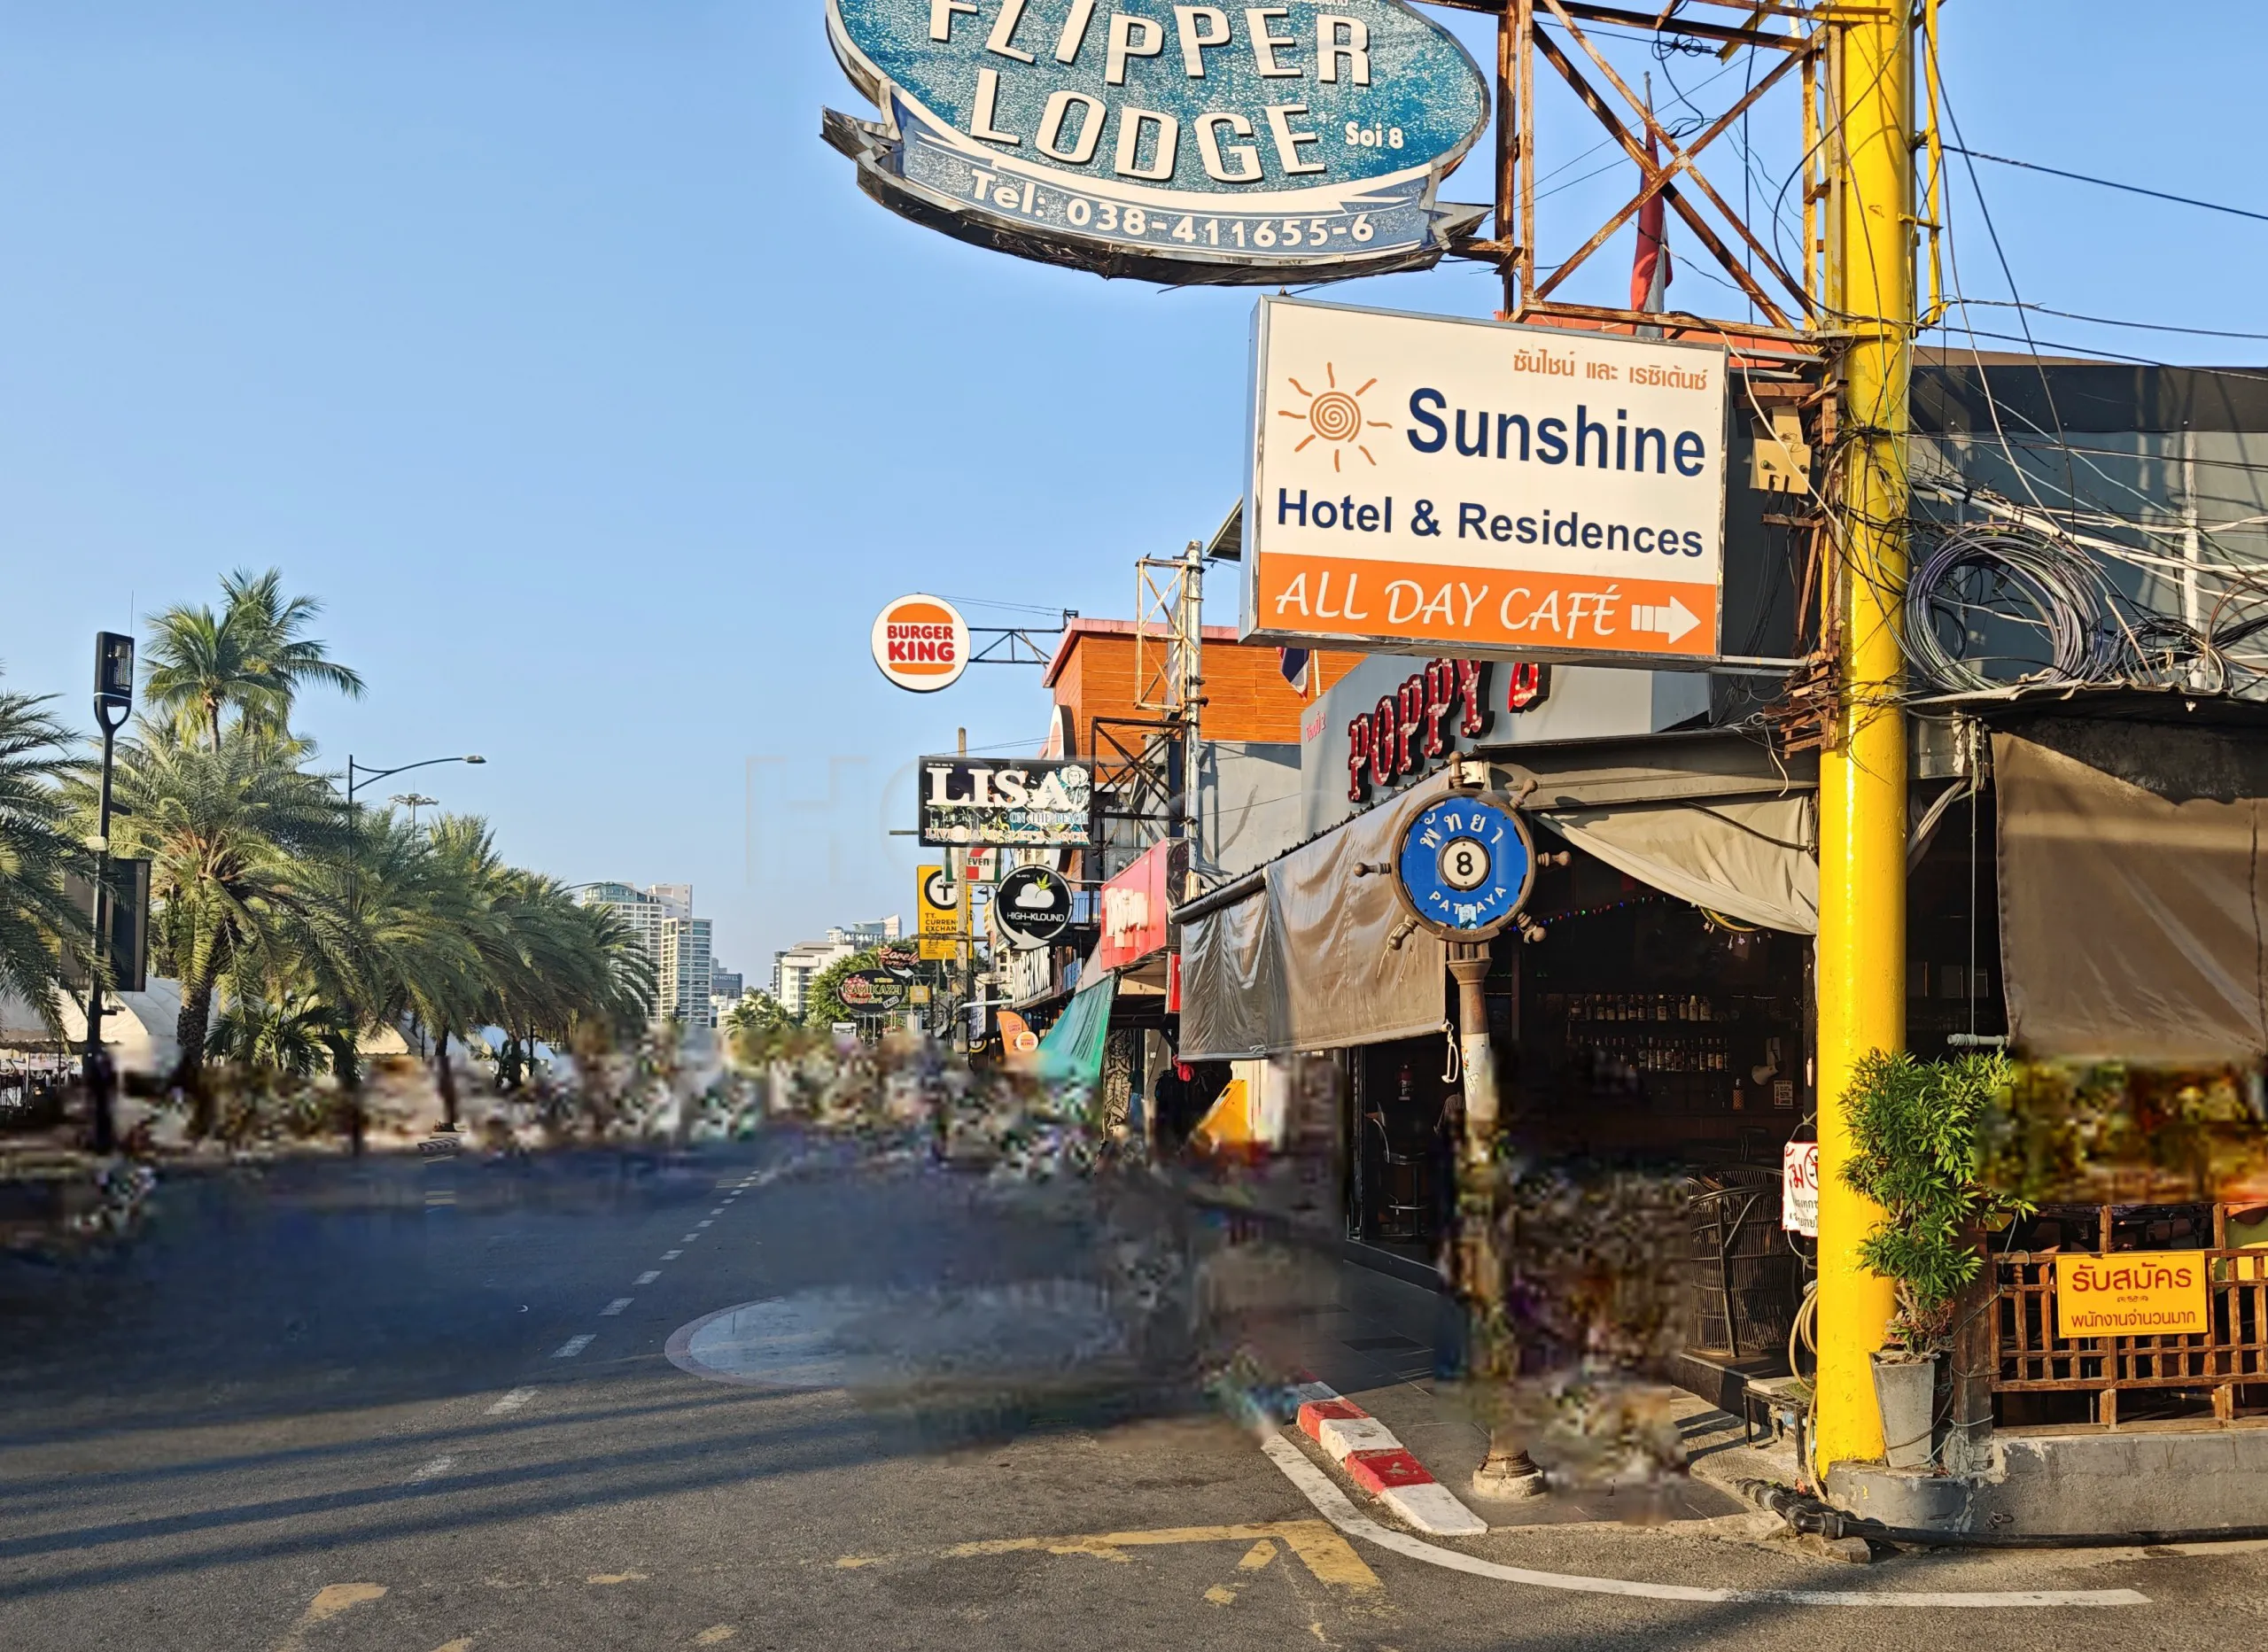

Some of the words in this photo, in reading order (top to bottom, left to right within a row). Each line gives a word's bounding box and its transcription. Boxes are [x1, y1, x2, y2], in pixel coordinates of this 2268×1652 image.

[929, 0, 1371, 86] FLIPPER
[970, 67, 1326, 182] LODGE
[1345, 120, 1383, 148] Soi
[1388, 128, 1404, 149] 8
[972, 168, 1046, 217] Tel:
[1067, 198, 1374, 247] 038-411655-6
[1586, 361, 1619, 381] และ
[1407, 387, 1706, 477] Sunshine
[1278, 487, 1393, 533] Hotel
[1410, 499, 1441, 538] &
[1458, 502, 1704, 558] Residences
[1275, 571, 1368, 622] ALL
[1384, 578, 1488, 627] DAY
[1500, 584, 1622, 640] CAFÉ
[887, 624, 954, 640] BURGER
[888, 640, 955, 663] KING
[926, 767, 1075, 809] LISA
[1009, 811, 1026, 824] ON
[1055, 812, 1089, 825] BEACH
[1419, 812, 1504, 849] พัทยา
[925, 827, 956, 839] LIVE
[1051, 831, 1089, 842] ROCK
[1456, 850, 1474, 877] 8
[2071, 1261, 2193, 1292] รับสมัคร
[2070, 1308, 2196, 1329] พนักงานจำนวนมาก
